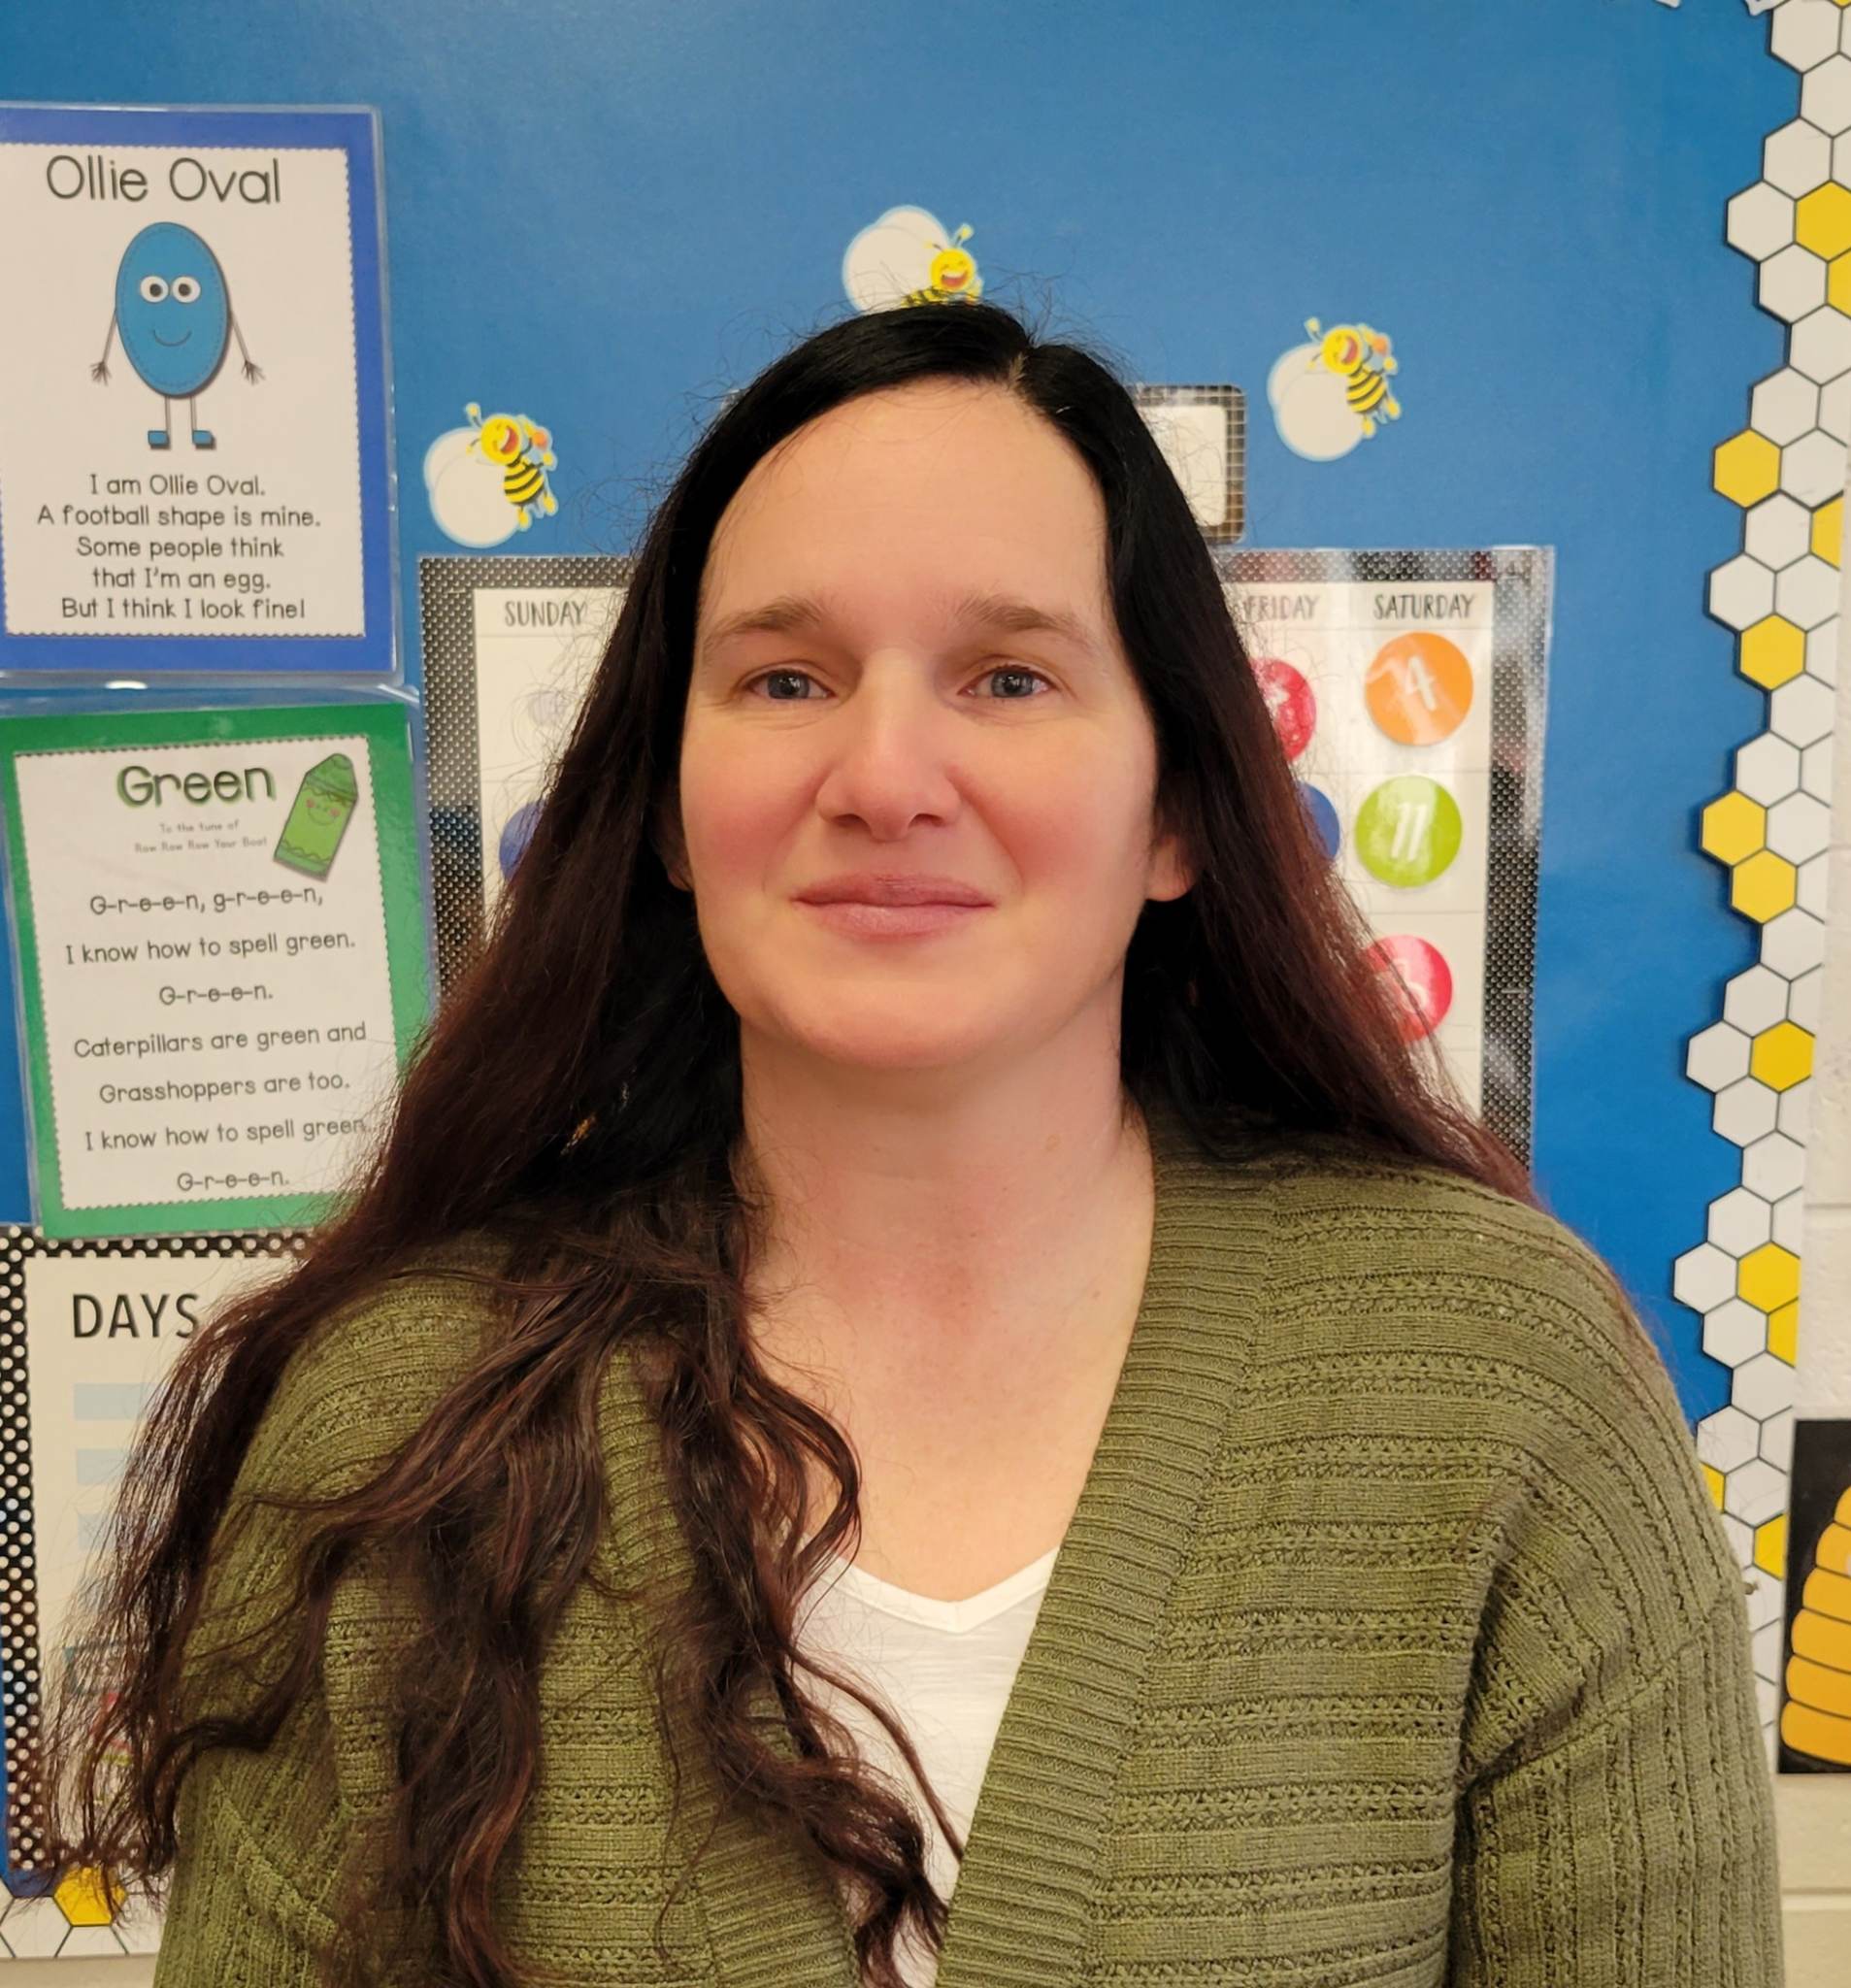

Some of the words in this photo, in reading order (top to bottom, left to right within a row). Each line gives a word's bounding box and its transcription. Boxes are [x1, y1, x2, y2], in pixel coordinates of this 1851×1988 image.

[46, 154, 149, 203] Ollie
[168, 156, 281, 205] Oval
[89, 473, 98, 495] I
[106, 479, 142, 495] am
[149, 474, 199, 496] Ollie
[206, 474, 266, 496] Oval.
[37, 504, 55, 525] A
[62, 504, 149, 526] football
[157, 506, 225, 531] shape
[233, 505, 252, 527] is
[260, 505, 320, 527] mine.
[76, 535, 141, 557] Some
[149, 537, 223, 562] people
[230, 536, 284, 558] think
[92, 567, 136, 588] that
[144, 566, 181, 589] I'm
[187, 573, 215, 589] an
[222, 573, 271, 594] egg.
[61, 597, 98, 618] But
[106, 597, 116, 619] I
[121, 597, 177, 618] think
[183, 597, 192, 619] I
[200, 598, 246, 619] look
[505, 600, 586, 627] SUNDAY
[1244, 594, 1320, 620] FRIDAY
[1372, 593, 1475, 620] SATURDAY
[116, 765, 276, 808] Green
[1389, 802, 1430, 863] 11
[65, 944, 75, 966] I
[82, 944, 139, 964] know
[147, 940, 191, 960] how
[198, 937, 221, 957] to
[229, 933, 279, 959] spell
[285, 933, 355, 957] green.
[73, 1033, 203, 1059] Caterpillars
[210, 1033, 248, 1050] are
[256, 1028, 320, 1052] green
[326, 1020, 367, 1043] and
[99, 1079, 256, 1105] Grasshoppers
[263, 1077, 302, 1094] are
[308, 1071, 350, 1091] too.
[84, 1131, 94, 1152] I
[100, 1131, 157, 1150] know
[165, 1126, 210, 1145] how
[216, 1123, 239, 1143] to
[247, 1118, 295, 1144] spell
[72, 1293, 200, 1339] DAYS
